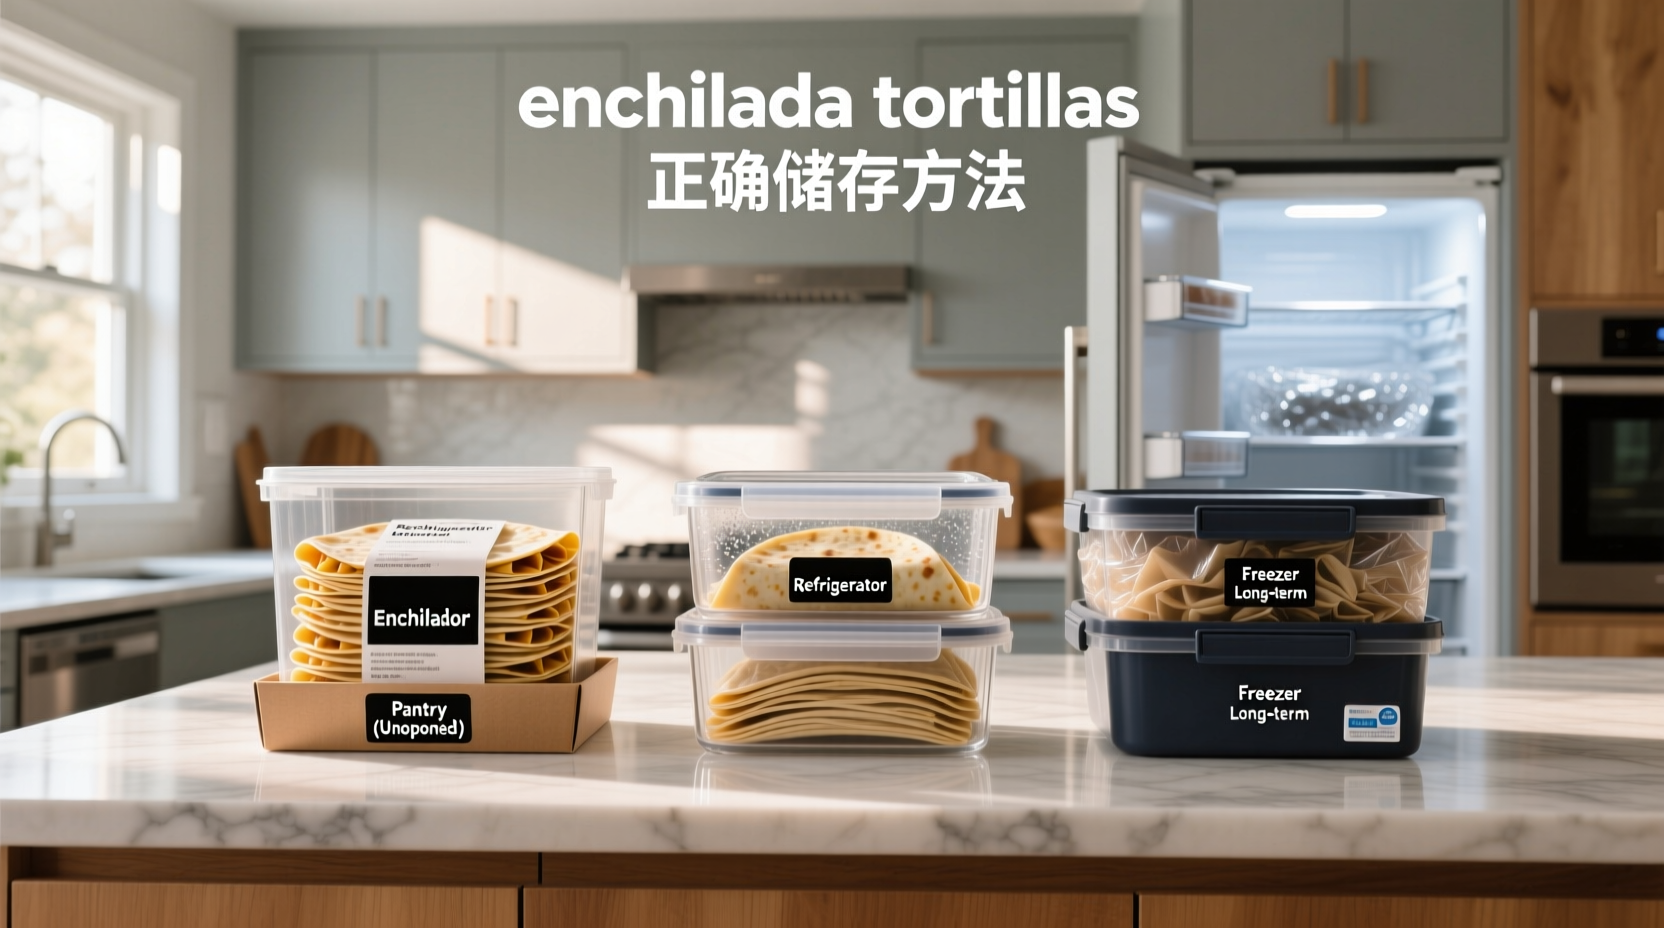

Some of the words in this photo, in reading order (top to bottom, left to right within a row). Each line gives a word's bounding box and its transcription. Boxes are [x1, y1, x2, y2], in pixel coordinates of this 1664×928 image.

[1242, 566, 1300, 582] Freezer
[793, 576, 888, 597] Refrigerator
[374, 607, 471, 627] Enchilador
[1238, 684, 1302, 701] Freezer
[391, 700, 448, 722] Pantry
[1230, 705, 1310, 725] Long-term
[373, 718, 465, 740] (Unoponed)
